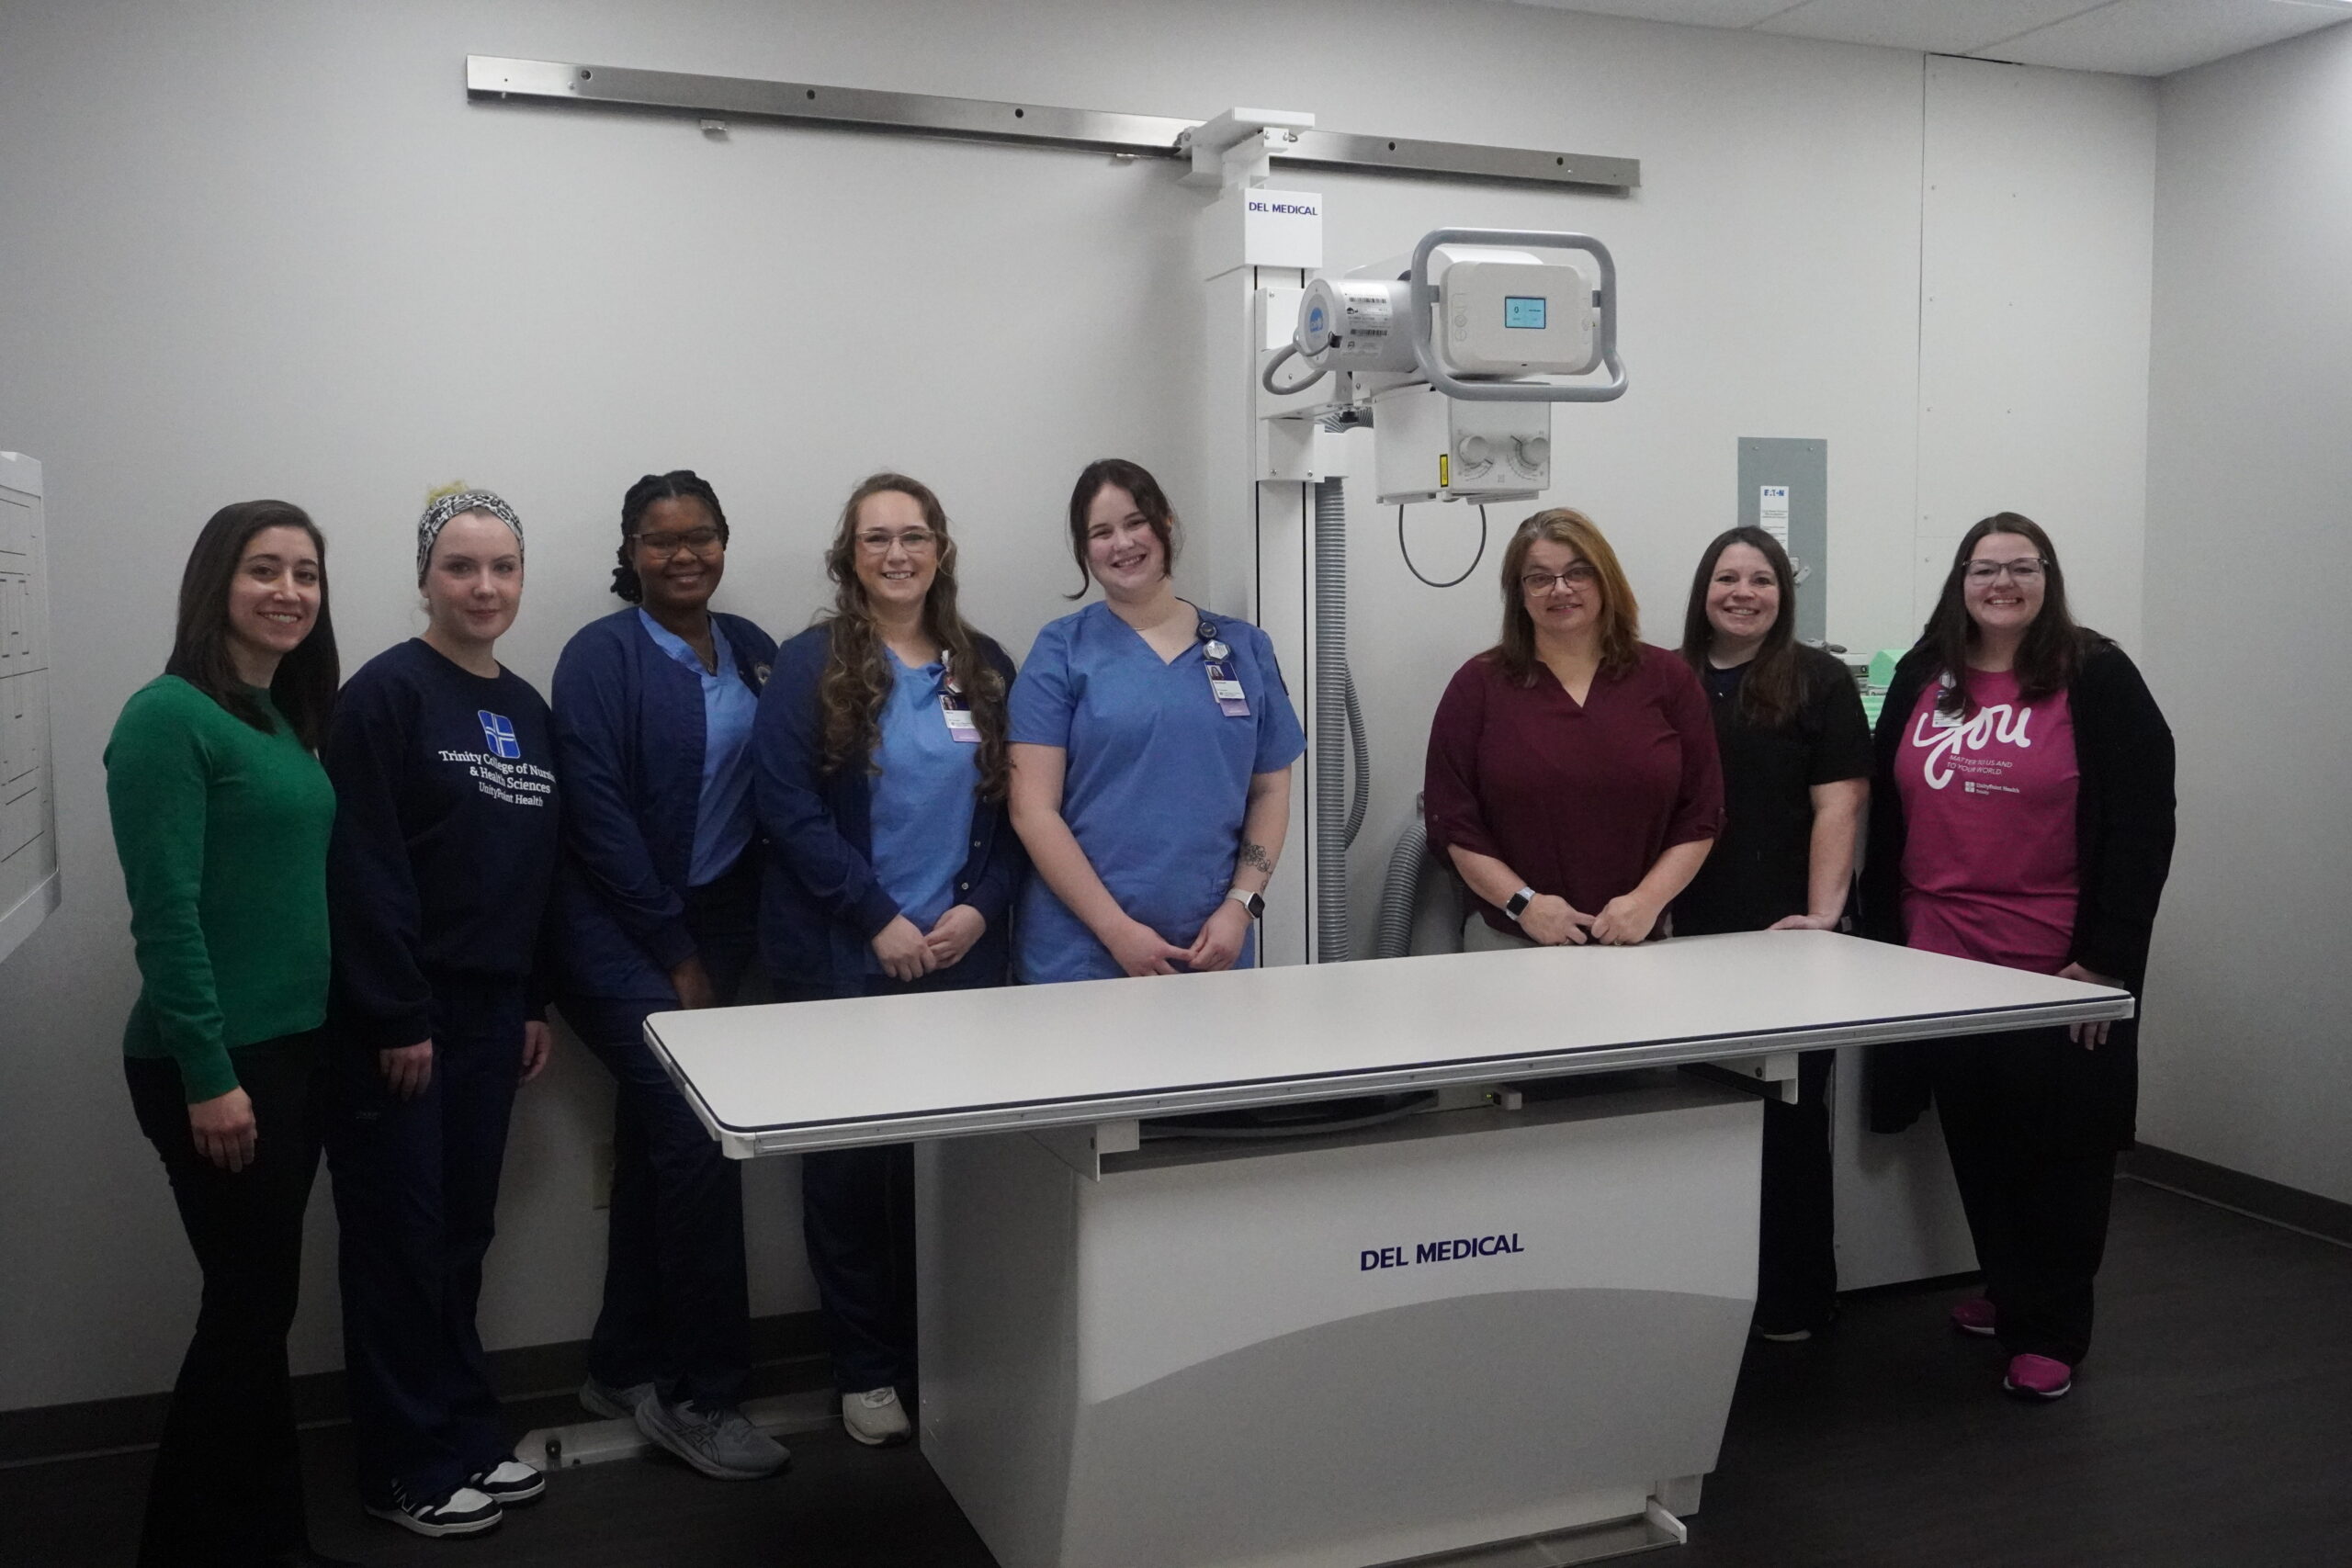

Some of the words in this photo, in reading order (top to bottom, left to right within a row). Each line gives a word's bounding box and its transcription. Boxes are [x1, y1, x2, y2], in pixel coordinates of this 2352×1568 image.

[1249, 201, 1269, 212] DEL
[1272, 203, 1318, 216] MEDICAL
[437, 750, 482, 765] Trinity
[482, 753, 514, 774] College
[515, 762, 528, 774] of
[1949, 754, 1976, 765] MATTER
[469, 766, 479, 776] &
[479, 766, 506, 787] Health
[506, 777, 551, 794] Sciences
[479, 782, 514, 804] UnityPoint
[514, 794, 544, 807] Health
[1361, 1247, 1409, 1271] DEL
[1416, 1233, 1525, 1264] MEDICAL
